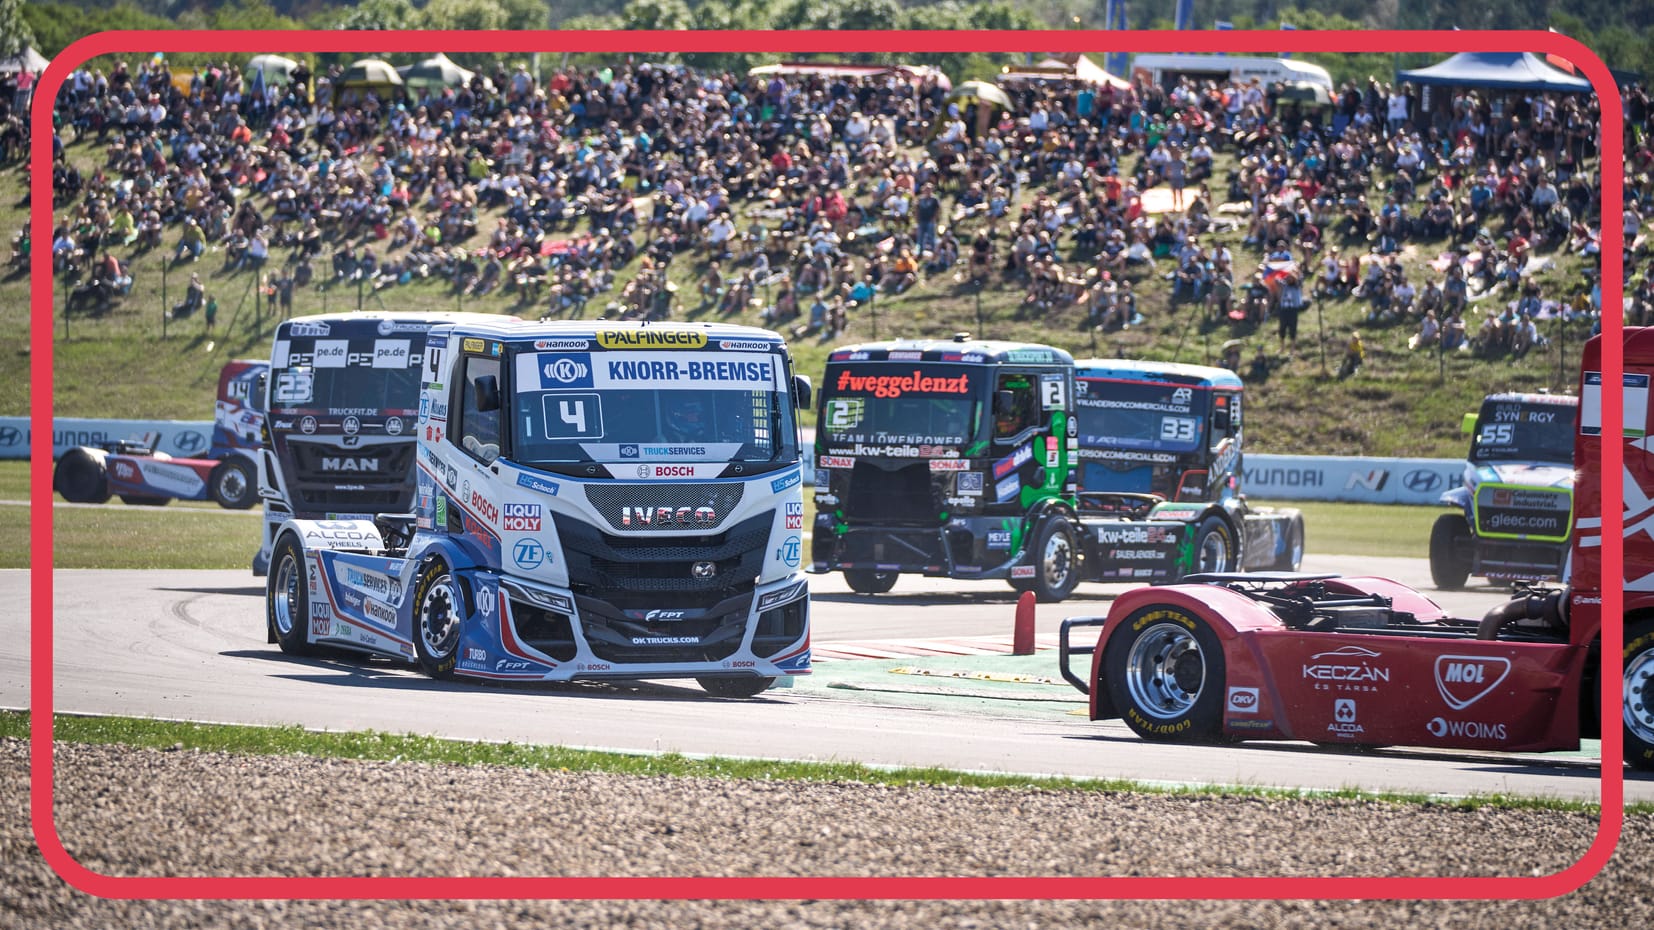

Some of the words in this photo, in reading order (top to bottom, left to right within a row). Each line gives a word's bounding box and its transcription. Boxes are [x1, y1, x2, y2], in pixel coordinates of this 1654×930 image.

[604, 331, 701, 345] PALFINGER
[730, 342, 769, 350] Hankook
[317, 345, 344, 357] pe.de
[377, 345, 405, 357] pe.de
[409, 354, 425, 367] P
[430, 349, 440, 382] 4
[608, 361, 772, 381] KNORR-BREMSE
[233, 383, 248, 398] 14
[279, 375, 311, 399] 23
[837, 371, 969, 397] #weggelenzt
[1050, 382, 1060, 404] 2
[1174, 388, 1192, 400] AR
[328, 408, 378, 417] TRUCKFIT.DE
[560, 401, 586, 432] 4
[832, 401, 849, 424] 2
[1495, 412, 1555, 422] SYNERGY
[1163, 418, 1193, 440] 33
[1483, 425, 1511, 443] 55
[643, 447, 706, 456] TRUCKSERVICES
[828, 444, 960, 458] www.lkw-teile24.de
[322, 458, 378, 470] MAN
[820, 457, 853, 467] SONAX
[930, 461, 966, 469] SONAX
[656, 466, 694, 476] BOSCH
[1242, 469, 1323, 486] YUNDAI
[472, 489, 499, 524] BOSCH
[504, 505, 540, 518] LIQUI
[787, 503, 803, 515] LIQ
[622, 506, 716, 525] IVECO
[787, 517, 803, 528] MO
[1491, 514, 1557, 528] gleec.com
[504, 518, 540, 530] MOLY
[306, 531, 379, 541] ALCOA
[988, 532, 1011, 542] MEYLE
[1098, 526, 1176, 544] lkw-teile24.de
[515, 544, 541, 563] ZF
[784, 543, 801, 560] ZF
[312, 604, 330, 618] LIQUI
[312, 619, 329, 634] MOLY
[469, 648, 487, 661] TURBO
[1445, 663, 1485, 683] MOL
[1232, 695, 1256, 704] DKV
[1327, 723, 1364, 733] ALCOA
[1448, 721, 1507, 739] WOIMS
